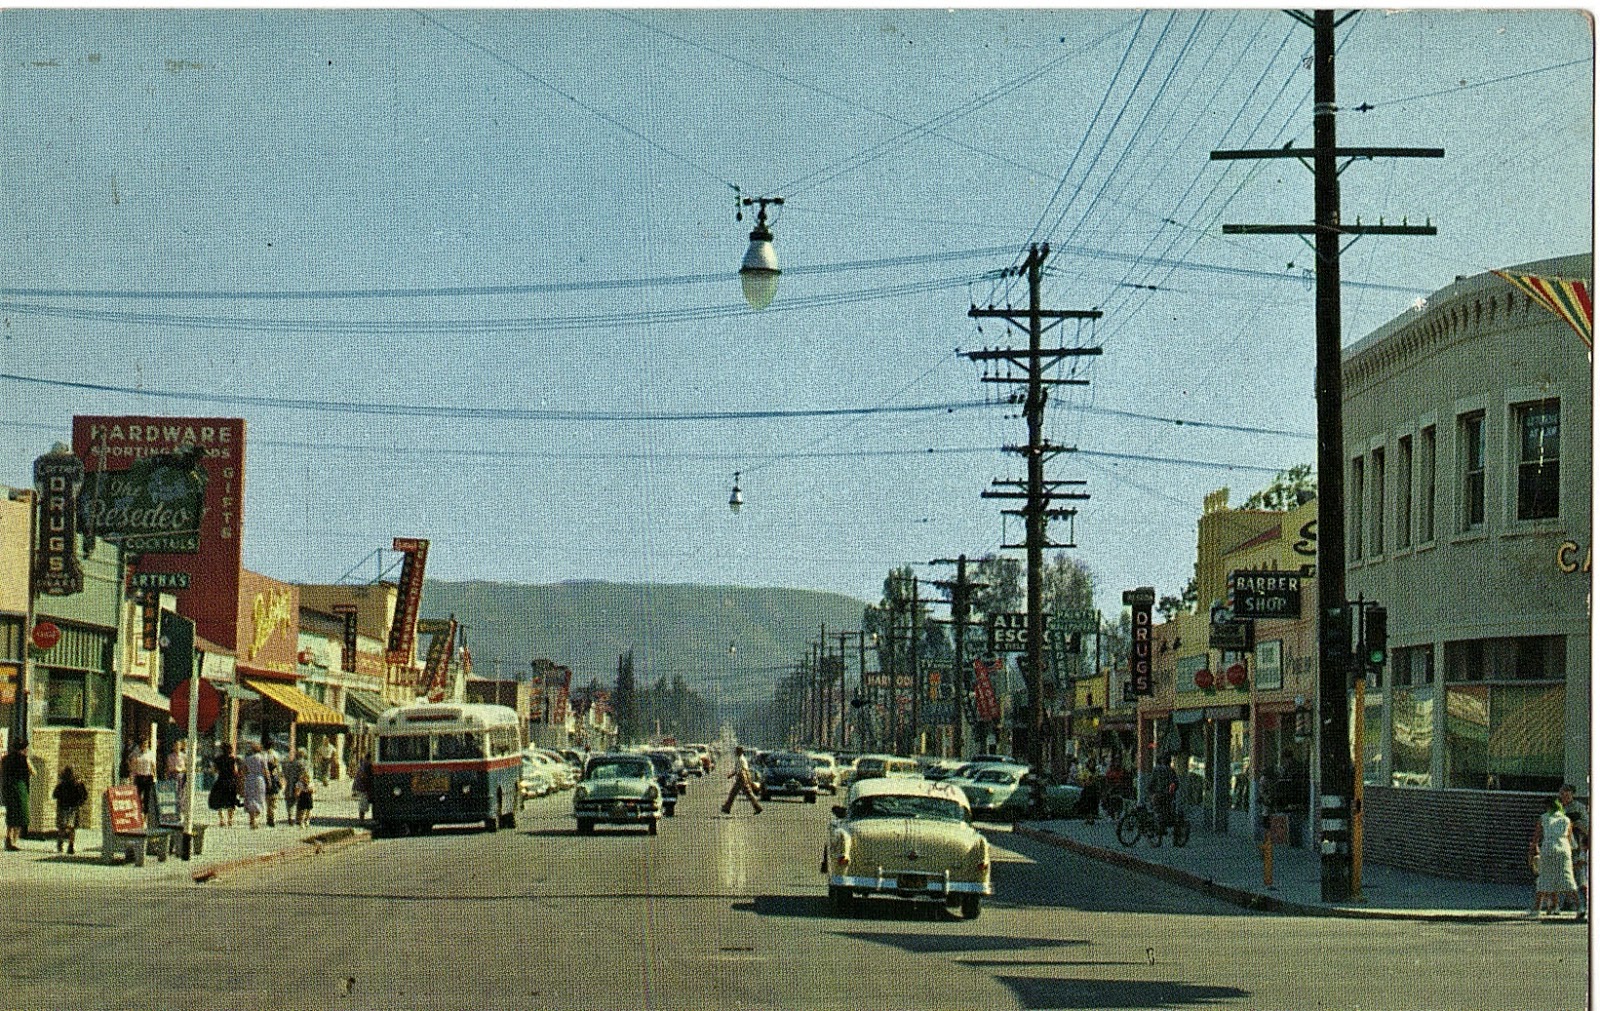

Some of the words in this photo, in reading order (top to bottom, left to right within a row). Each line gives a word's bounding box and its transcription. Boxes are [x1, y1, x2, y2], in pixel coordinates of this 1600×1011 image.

[91, 425, 233, 444] HARDWARE
[221, 467, 234, 539] GIFTS
[49, 476, 66, 572] DRUGS
[125, 537, 198, 551] COCKTAILS
[1236, 577, 1299, 593] BARBER
[1245, 595, 1287, 612] SHOP
[1136, 611, 1149, 690] DRUGS
